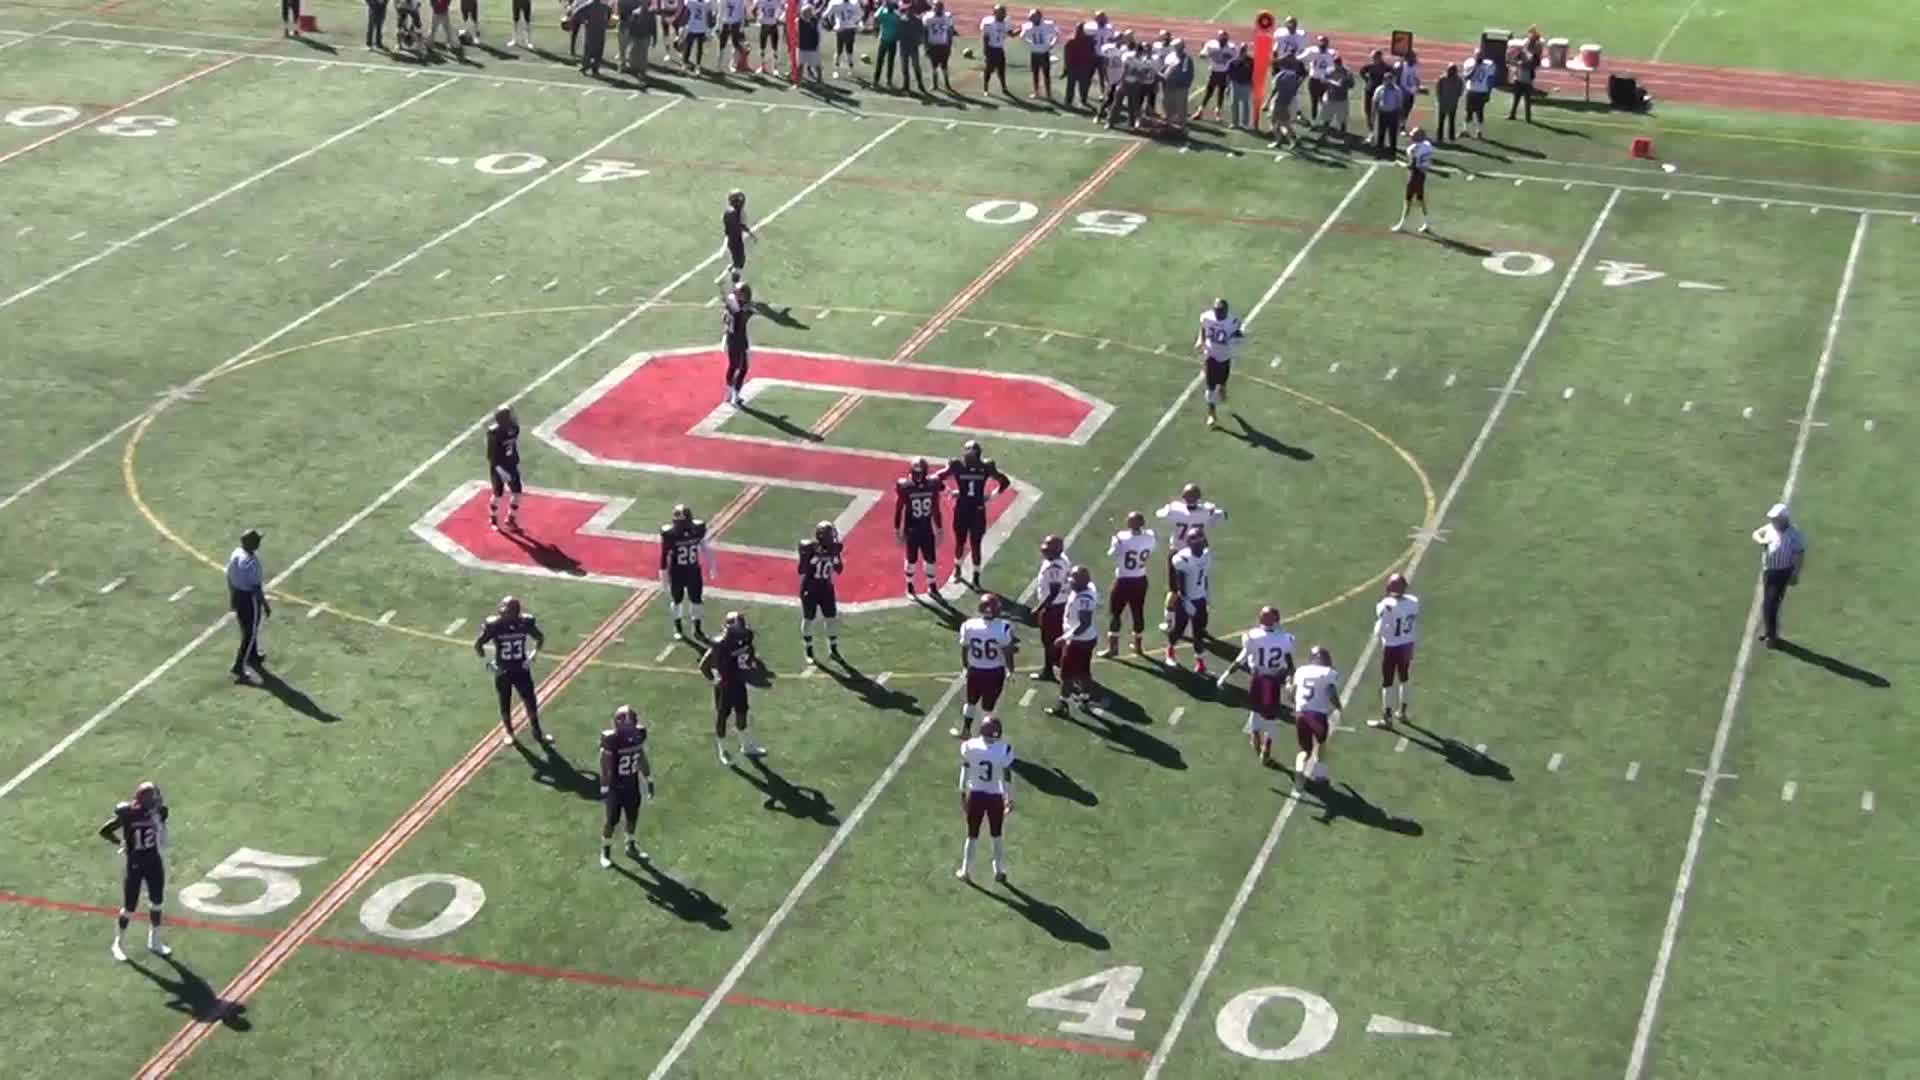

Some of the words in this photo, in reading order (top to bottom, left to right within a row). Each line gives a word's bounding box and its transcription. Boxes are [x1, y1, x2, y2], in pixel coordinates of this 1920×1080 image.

[911, 497, 933, 519] 99
[1124, 550, 1151, 571] 69
[501, 638, 524, 660] 23
[971, 638, 999, 660] 66
[1257, 647, 1283, 668] 12
[1302, 679, 1315, 700] 5
[978, 761, 993, 782] 3
[133, 828, 157, 850] 12
[180, 847, 487, 941] 50
[1026, 965, 1340, 1062] 40
